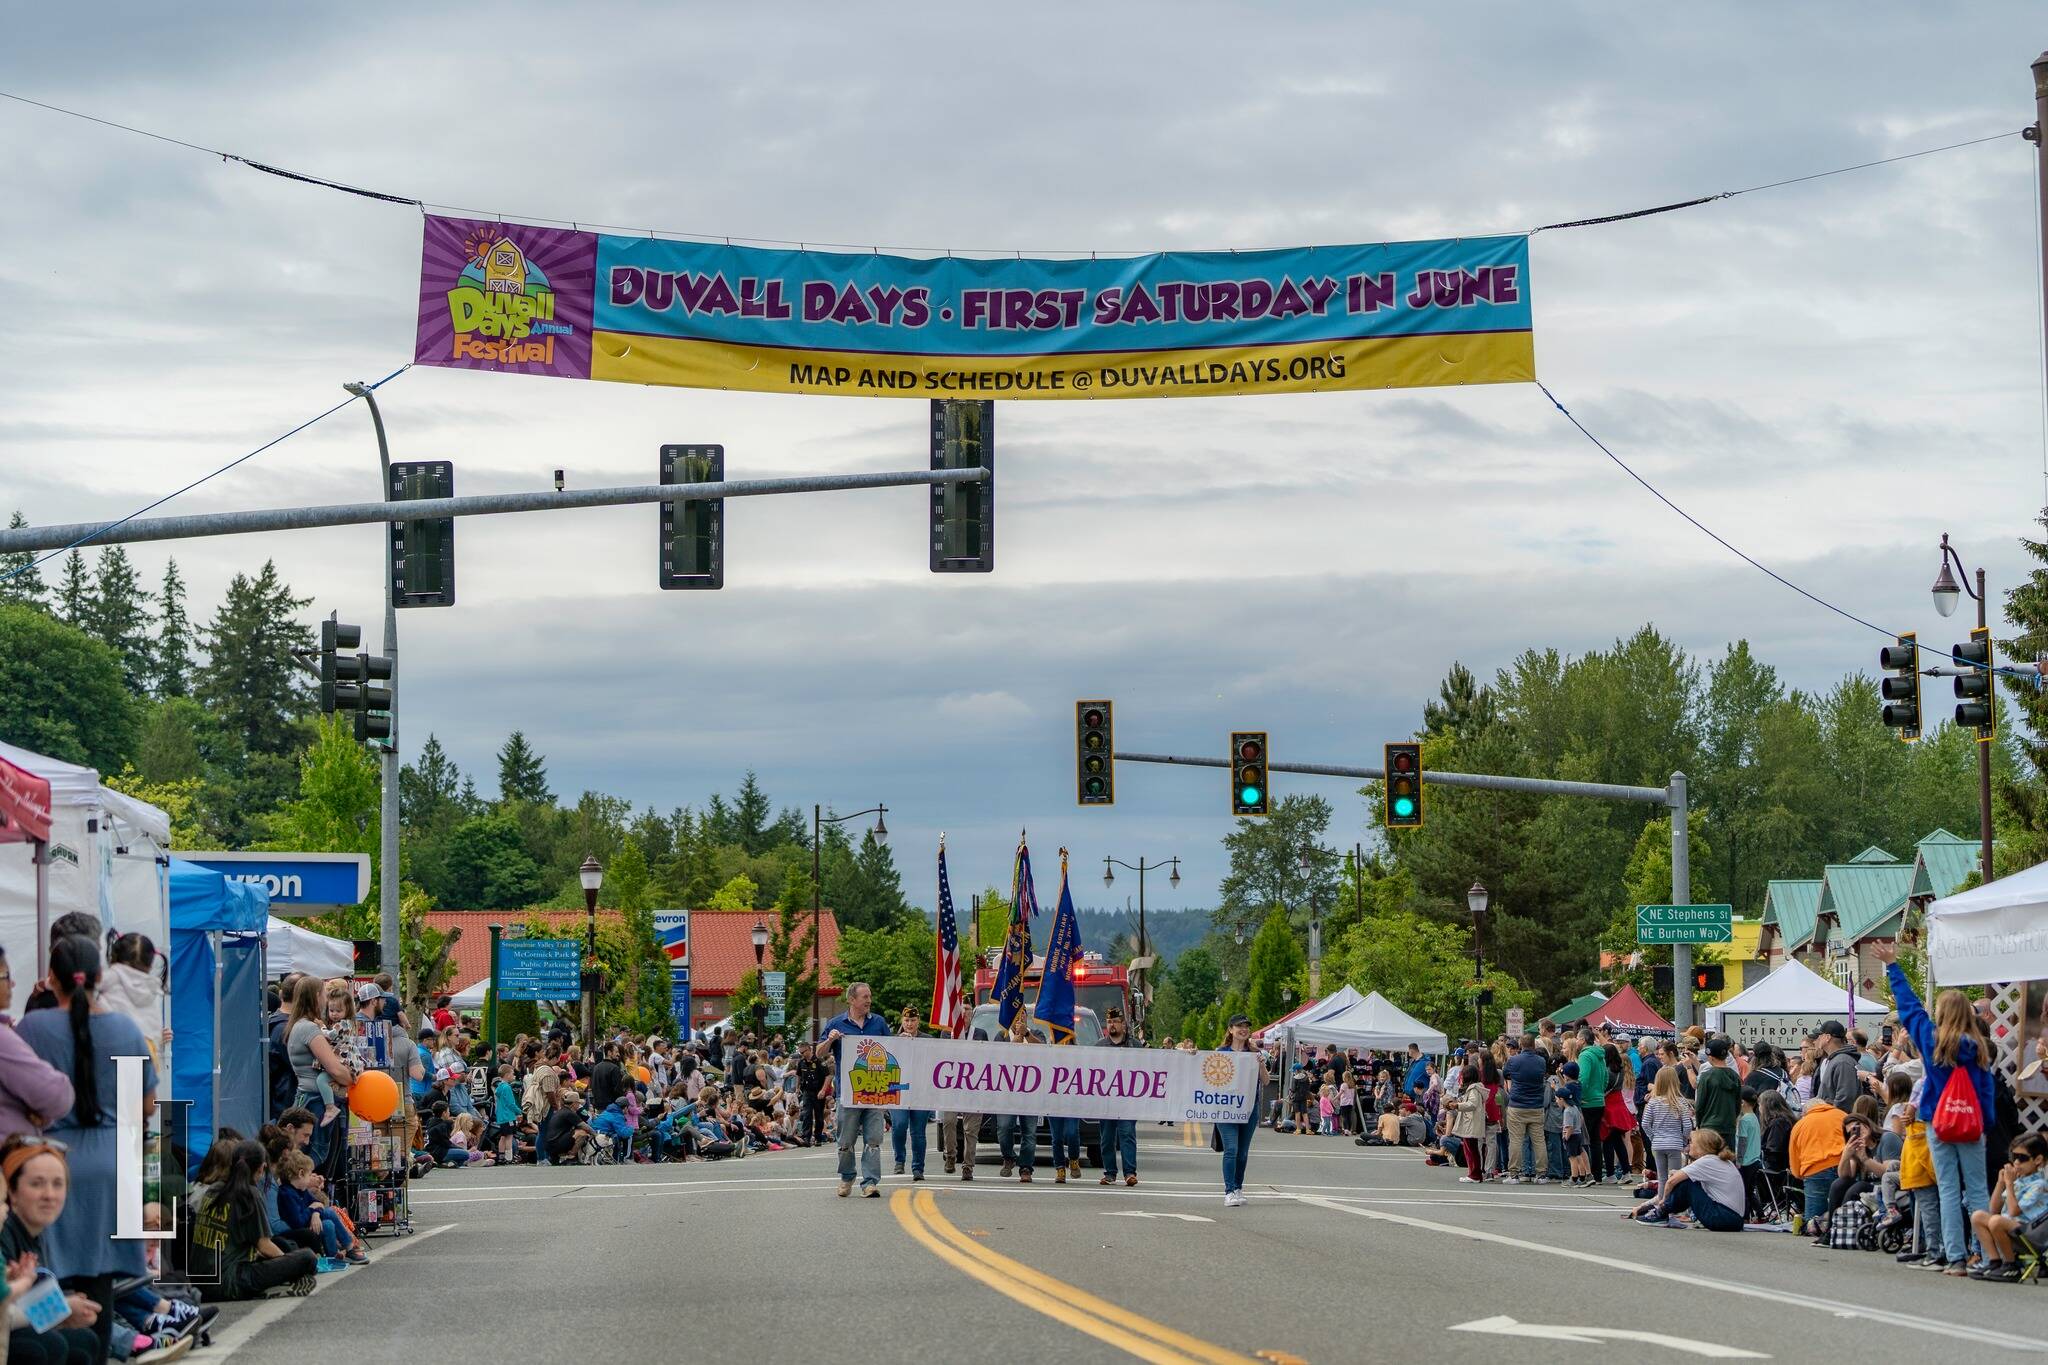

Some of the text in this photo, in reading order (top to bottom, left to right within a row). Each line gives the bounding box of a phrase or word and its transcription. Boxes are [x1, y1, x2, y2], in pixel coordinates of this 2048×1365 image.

[610, 264, 1517, 331] DUVALL DAYS FIRST SATURDAY IN JUNE
[448, 287, 555, 333] Duvall
[531, 321, 573, 336] Annual
[453, 334, 555, 365] Festival
[789, 355, 1346, 391] MAP AND SCHEDULE @ DUVALLDAYS.ORG
[655, 914, 686, 923] evron
[1649, 908, 1728, 922] NE Stephens St
[1640, 927, 1719, 941] NE Burhen Way
[537, 941, 554, 949] Valley
[543, 961, 570, 969] Parking
[552, 970, 570, 978] Depot
[529, 980, 570, 988] Department
[1740, 1036, 1794, 1045] HEALTH
[848, 1069, 900, 1092] Duvall
[932, 1061, 1168, 1099] GRAND PARADE
[852, 1093, 901, 1106] Festival
[1194, 1090, 1244, 1109] Rotary
[1185, 1108, 1208, 1119] Club
[1211, 1109, 1221, 1119] of
